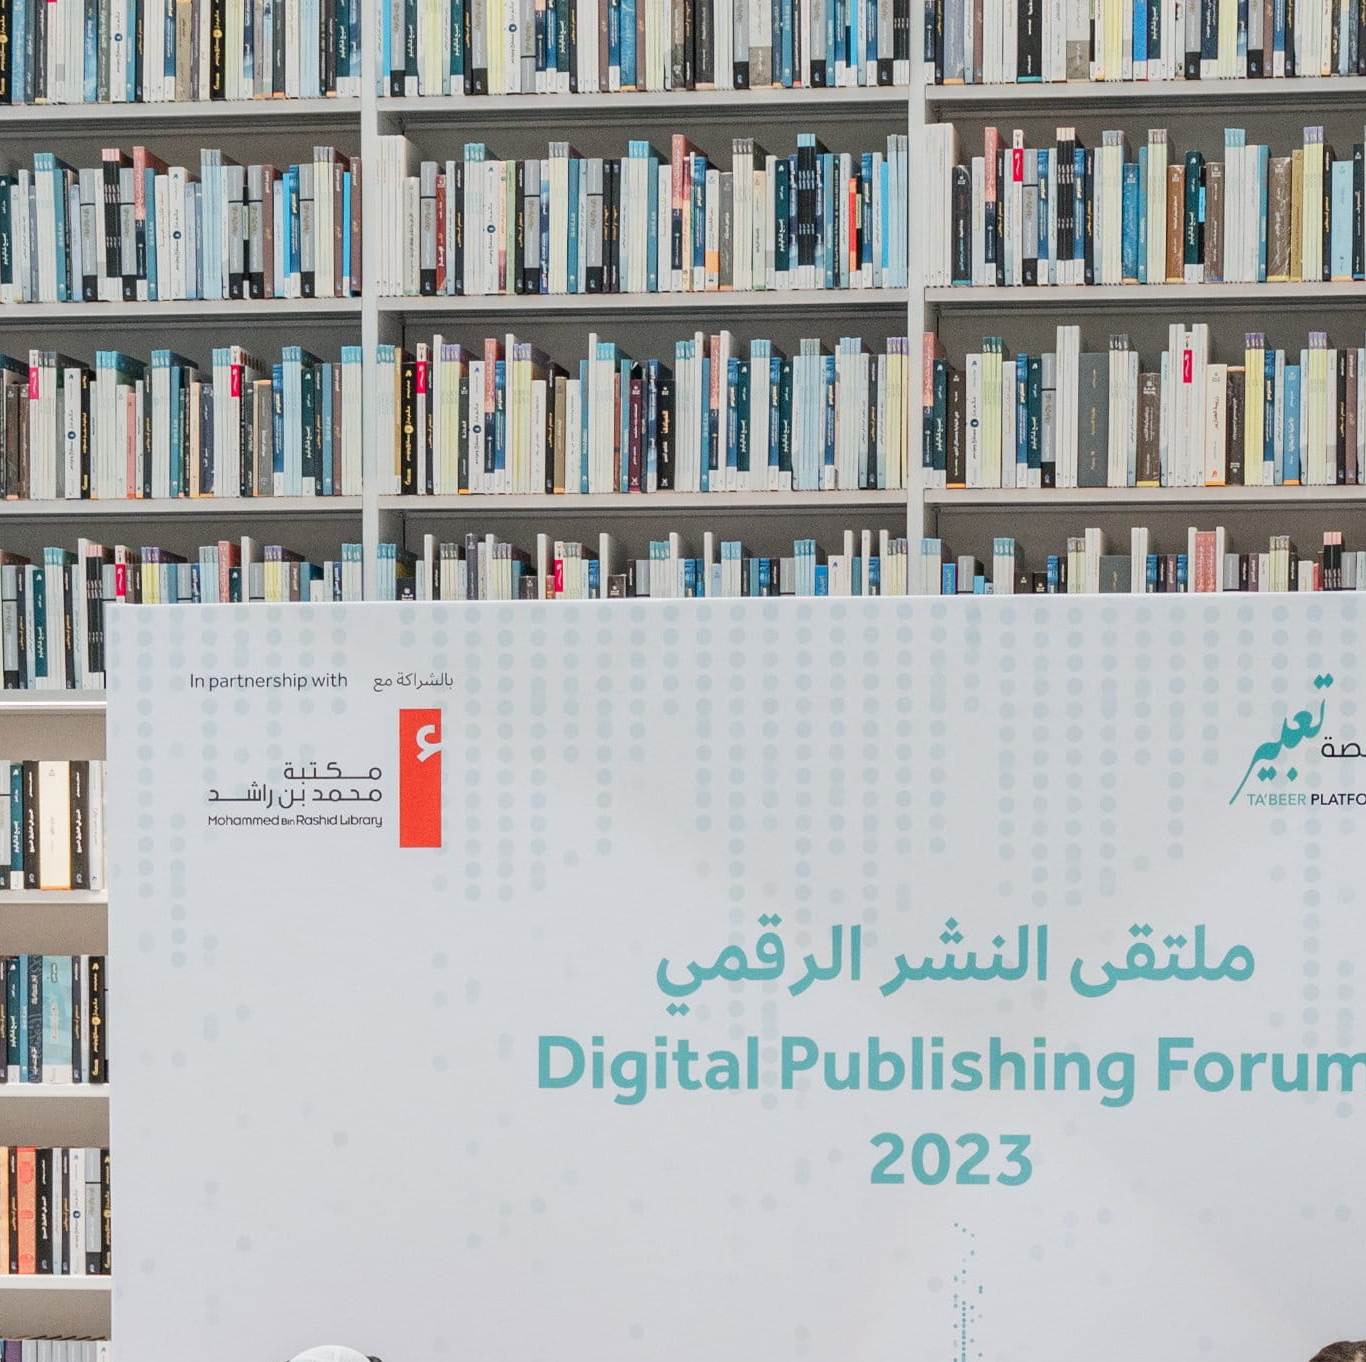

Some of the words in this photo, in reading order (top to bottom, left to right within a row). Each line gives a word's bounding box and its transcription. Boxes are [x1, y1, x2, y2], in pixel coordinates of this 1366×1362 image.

[190, 673, 205, 689] In
[209, 673, 308, 692] partnership
[311, 672, 348, 688] with
[373, 677, 393, 693] مع
[396, 671, 454, 690] بالشراكة
[283, 761, 383, 784] مكتبة
[208, 780, 273, 809] راشد
[278, 781, 306, 809] بن
[311, 788, 383, 802] محمد
[208, 815, 280, 826] Mohammed
[281, 817, 295, 826] Bin
[296, 814, 338, 826] Rashid
[339, 814, 383, 829] Library
[656, 912, 862, 1017] الرقمي
[878, 916, 1048, 998] النشر
[1069, 923, 1255, 998] ملتقى
[538, 1035, 759, 1106] Digital
[781, 1035, 1136, 1108] Publishing
[869, 1132, 1033, 1187] 2023
